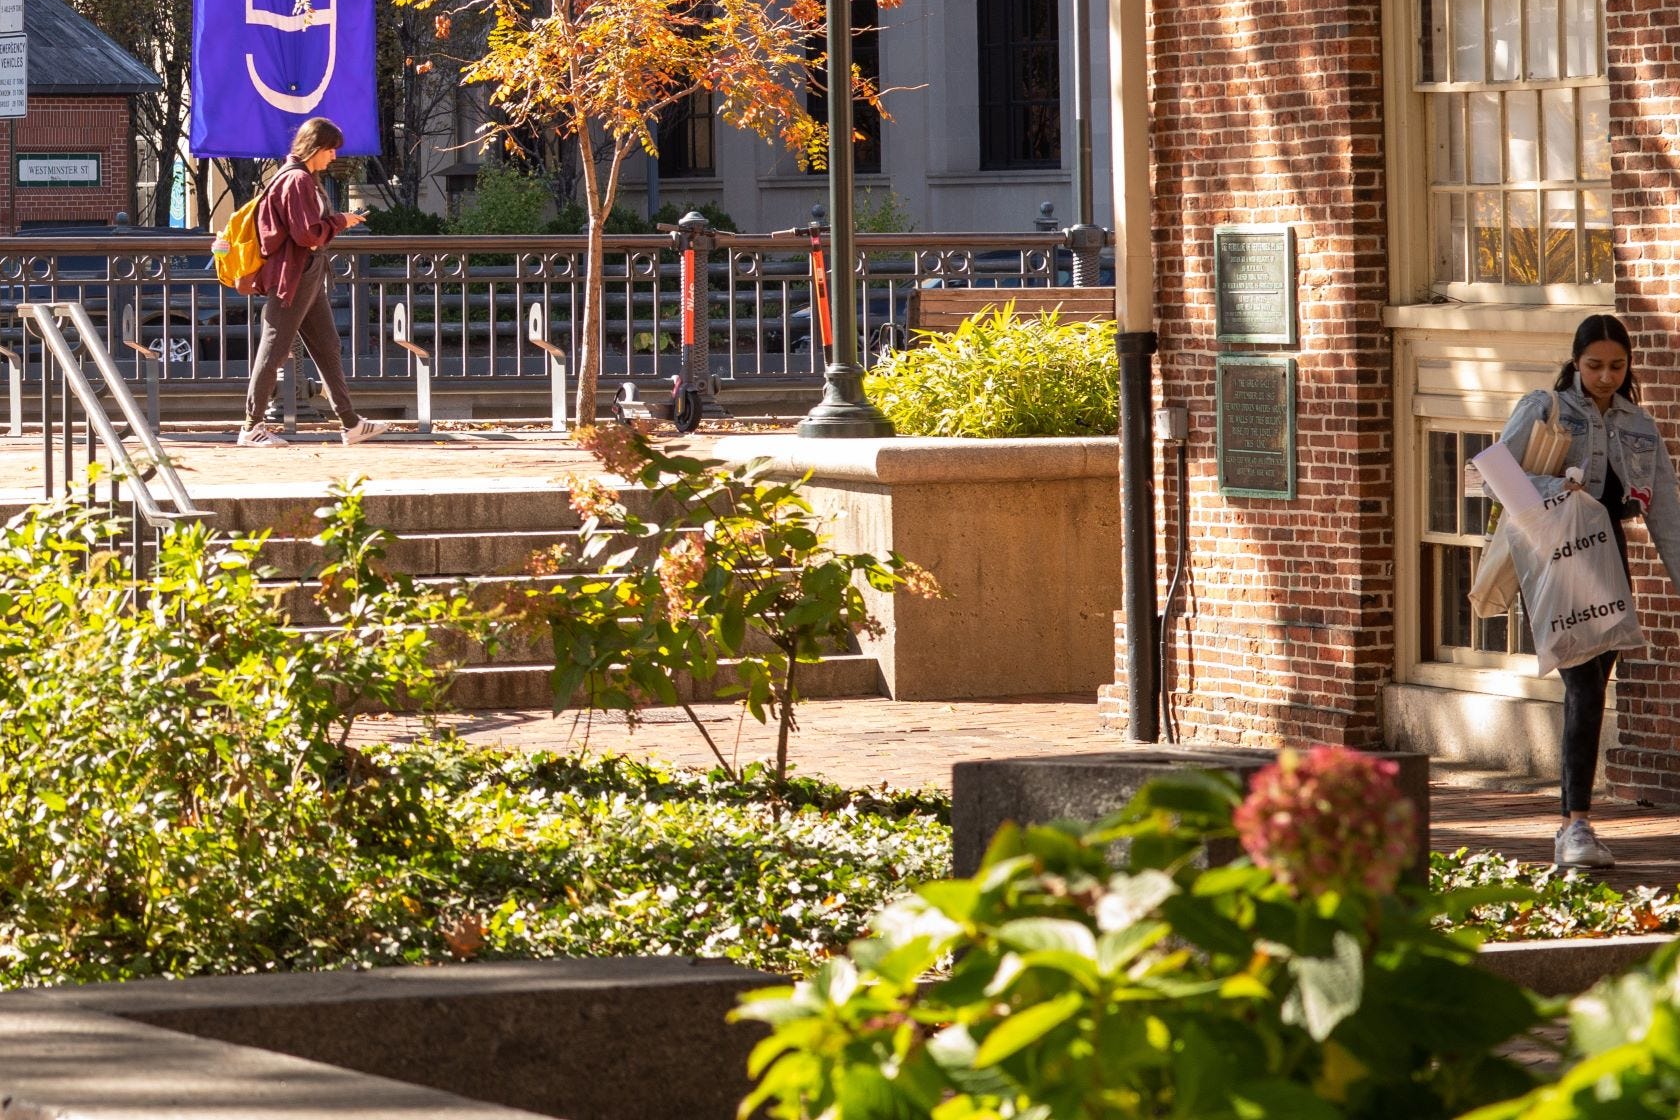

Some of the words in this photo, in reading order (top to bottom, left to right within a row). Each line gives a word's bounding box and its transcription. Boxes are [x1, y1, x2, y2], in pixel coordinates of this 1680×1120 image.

[0, 42, 26, 54] EMERGENCY
[1, 57, 23, 68] VEHICLES
[28, 165, 78, 175] WESTMINSTER
[80, 165, 89, 174] ST
[1543, 490, 1572, 510] ris
